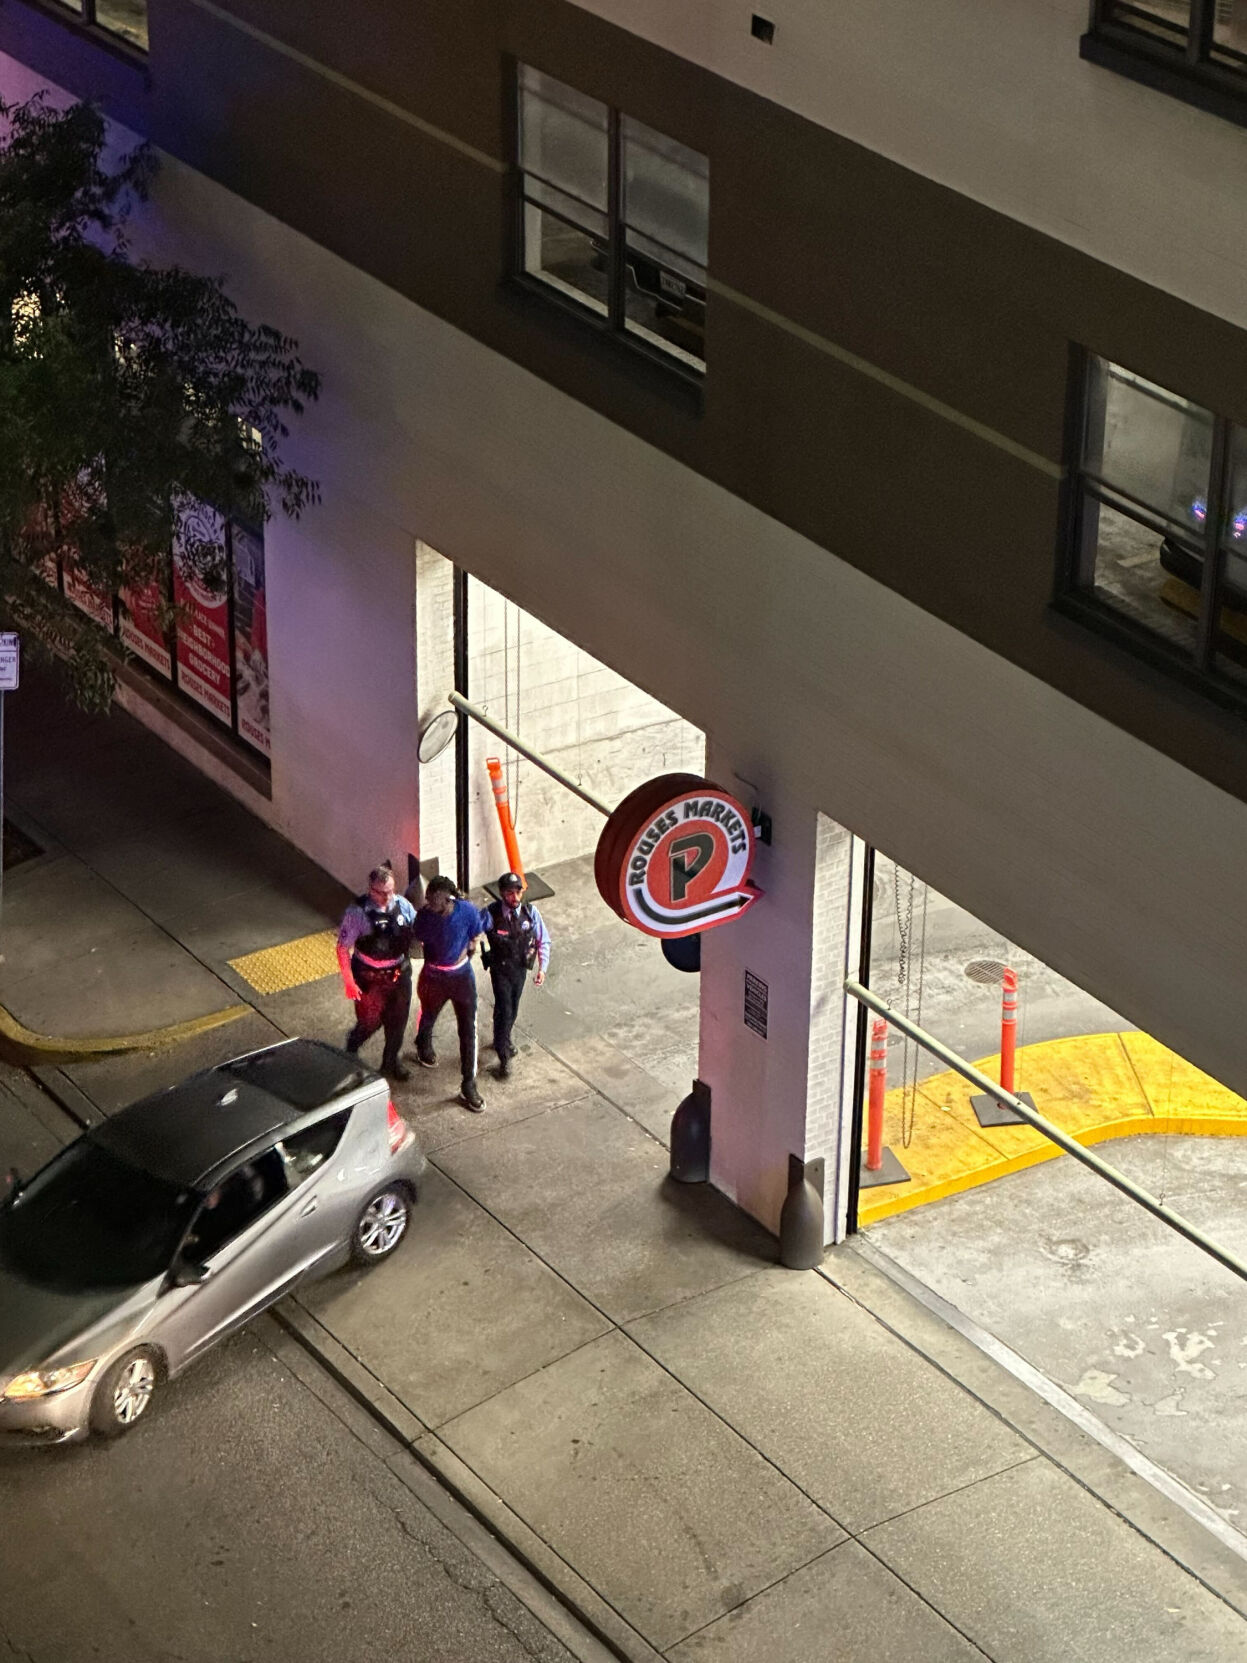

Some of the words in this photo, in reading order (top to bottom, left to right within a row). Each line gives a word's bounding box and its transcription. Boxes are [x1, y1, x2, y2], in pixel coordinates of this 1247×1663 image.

[193, 624, 211, 647] BEST
[188, 652, 221, 685] GROCERY
[628, 809, 679, 886] ROUSES
[683, 800, 747, 855] MARKETS
